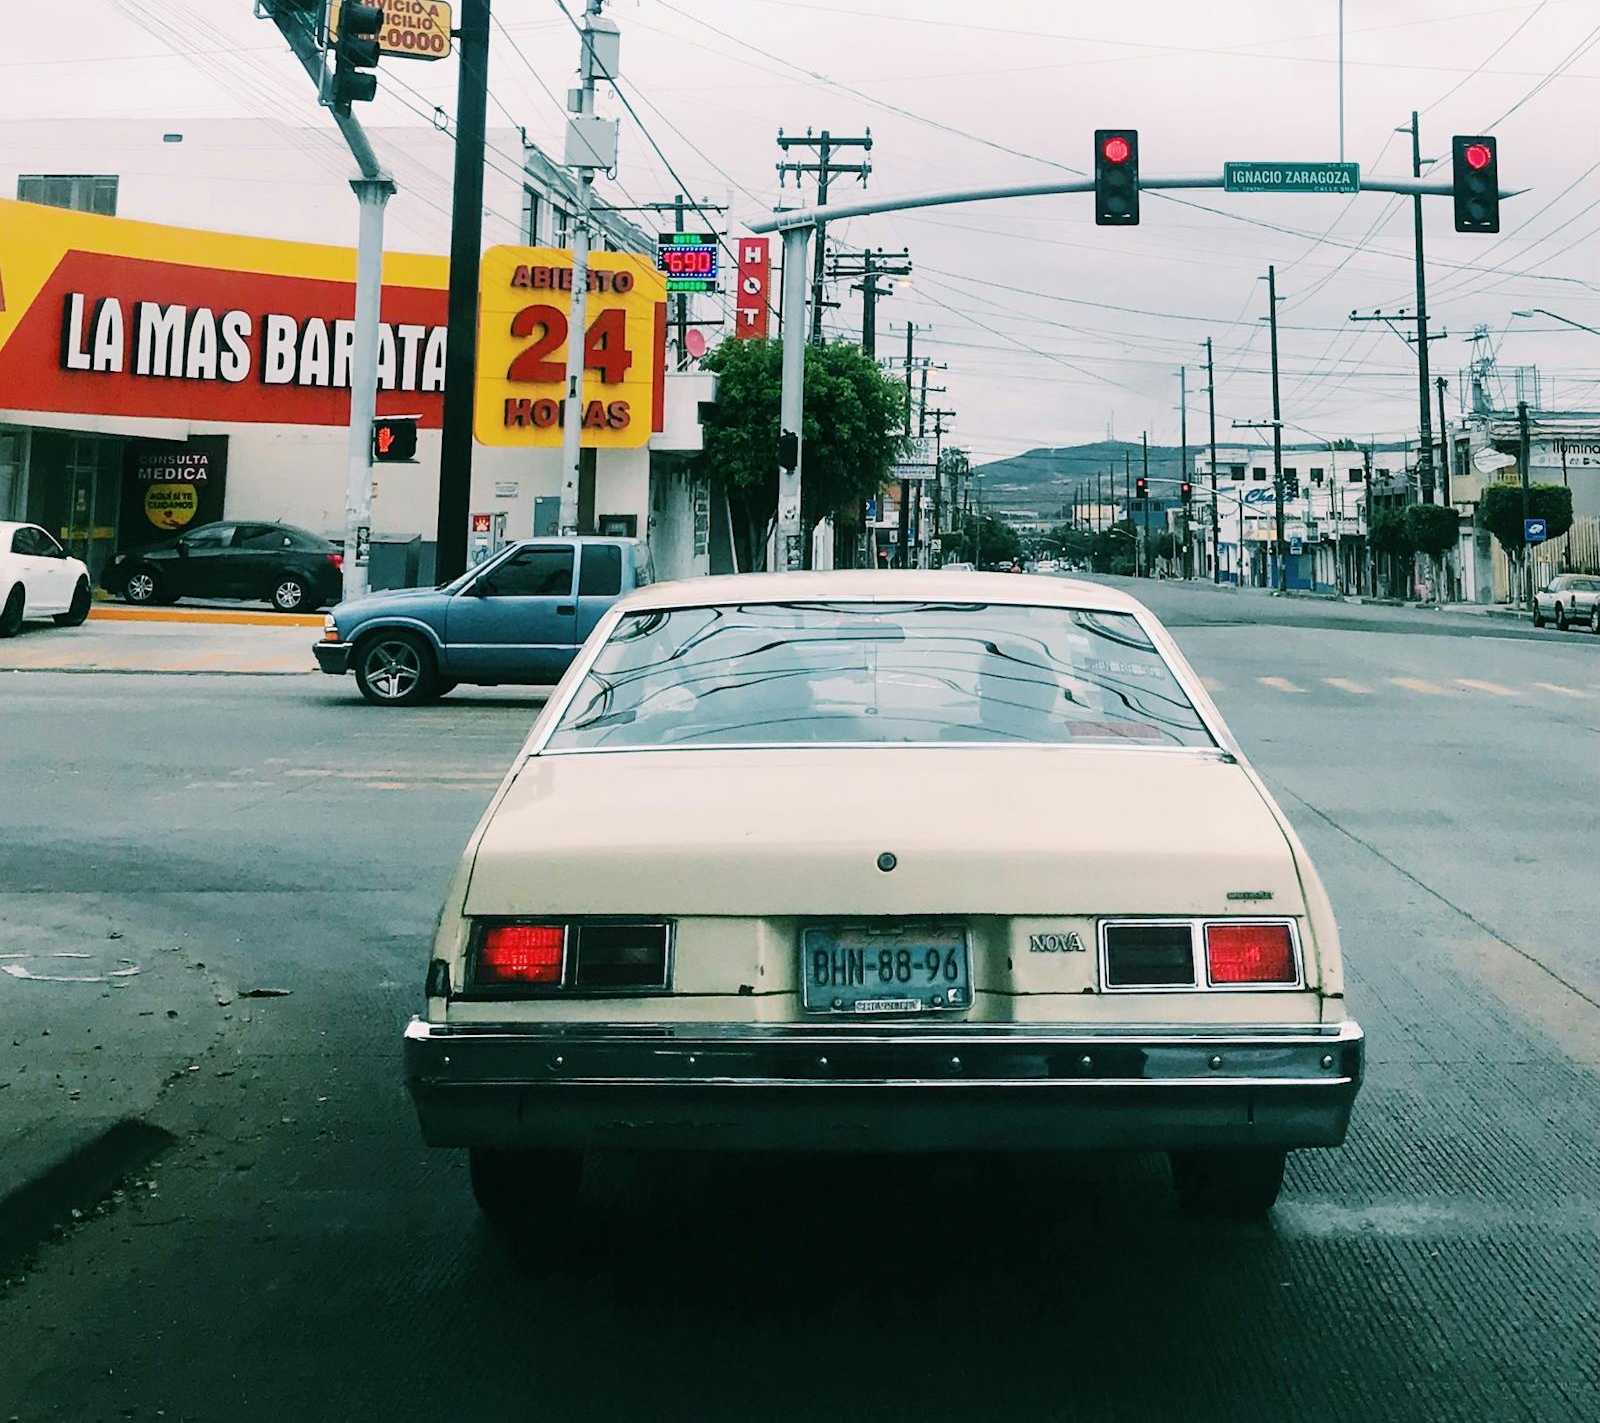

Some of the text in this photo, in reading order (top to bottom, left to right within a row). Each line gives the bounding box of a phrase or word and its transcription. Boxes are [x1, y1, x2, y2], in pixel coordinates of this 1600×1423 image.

[428, 4, 440, 17] A
[385, 12, 433, 30] ICILIO
[357, 28, 445, 53] -0000
[1232, 170, 1351, 184] IGNACIO ZARAGOZA
[65, 292, 448, 392] LA MAS BARATA
[507, 303, 633, 384] 24
[504, 398, 631, 429] HOAS
[139, 454, 209, 465] CONSULTA
[138, 467, 207, 480] MEDICA
[1029, 932, 1086, 952] NOVA
[812, 948, 958, 988] BHN-88-96
